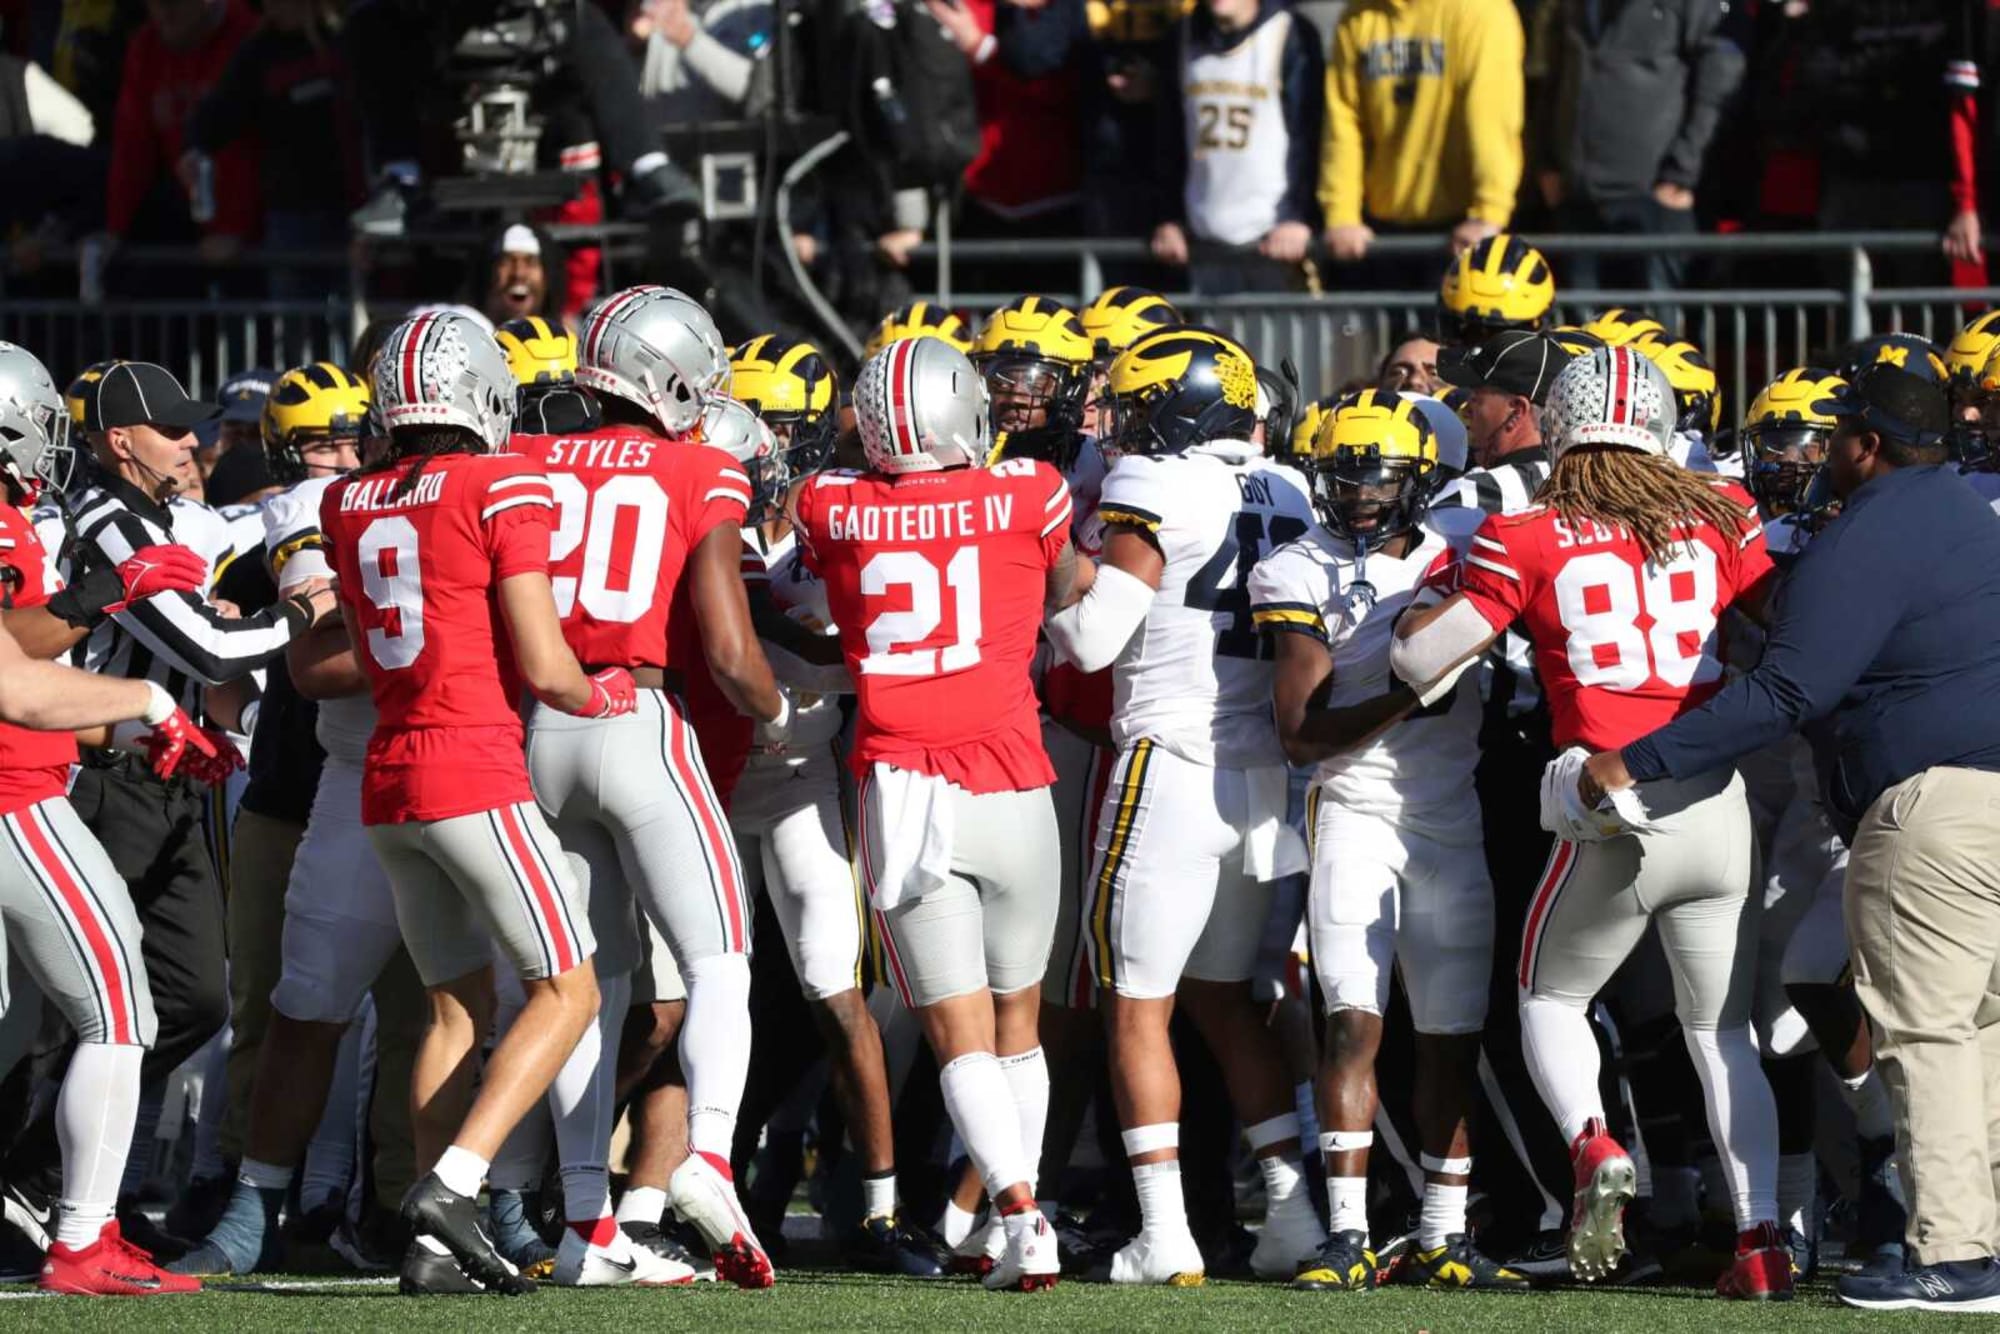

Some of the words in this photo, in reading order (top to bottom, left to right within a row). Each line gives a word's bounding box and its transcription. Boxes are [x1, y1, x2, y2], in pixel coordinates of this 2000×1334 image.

[1199, 104, 1251, 149] 25
[1876, 345, 1909, 367] M
[546, 439, 656, 467] STYLES
[340, 470, 447, 512] BALLARD
[1234, 473, 1275, 507] GUY
[828, 500, 975, 541] GAOTEOTE
[984, 494, 1013, 532] IV
[546, 472, 669, 624] 20
[358, 515, 425, 670] 9
[859, 545, 982, 675] 21
[1554, 538, 1723, 690] 88
